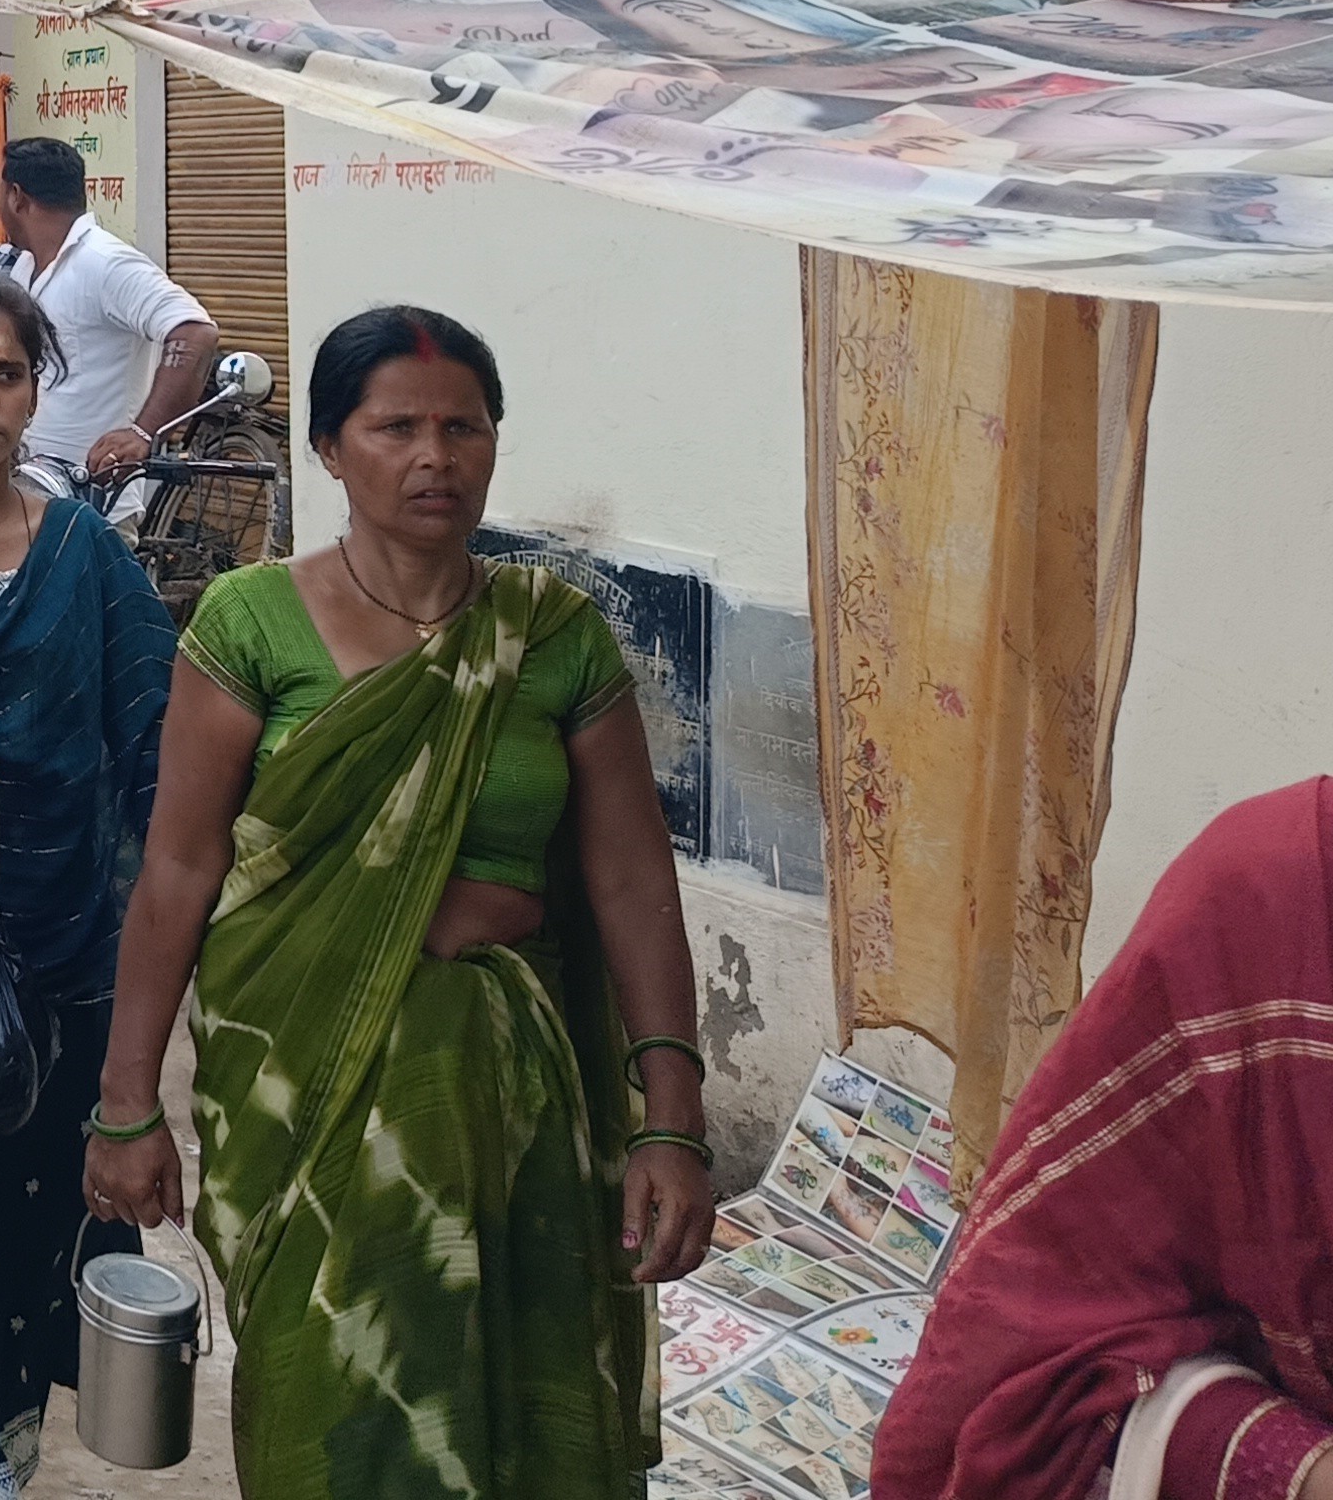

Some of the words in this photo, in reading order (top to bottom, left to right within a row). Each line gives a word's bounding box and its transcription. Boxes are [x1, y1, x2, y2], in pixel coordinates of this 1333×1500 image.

[36, 78, 50, 126] श्री
[107, 75, 129, 120] सिंह
[99, 176, 125, 215] यादव
[293, 163, 325, 193] राज
